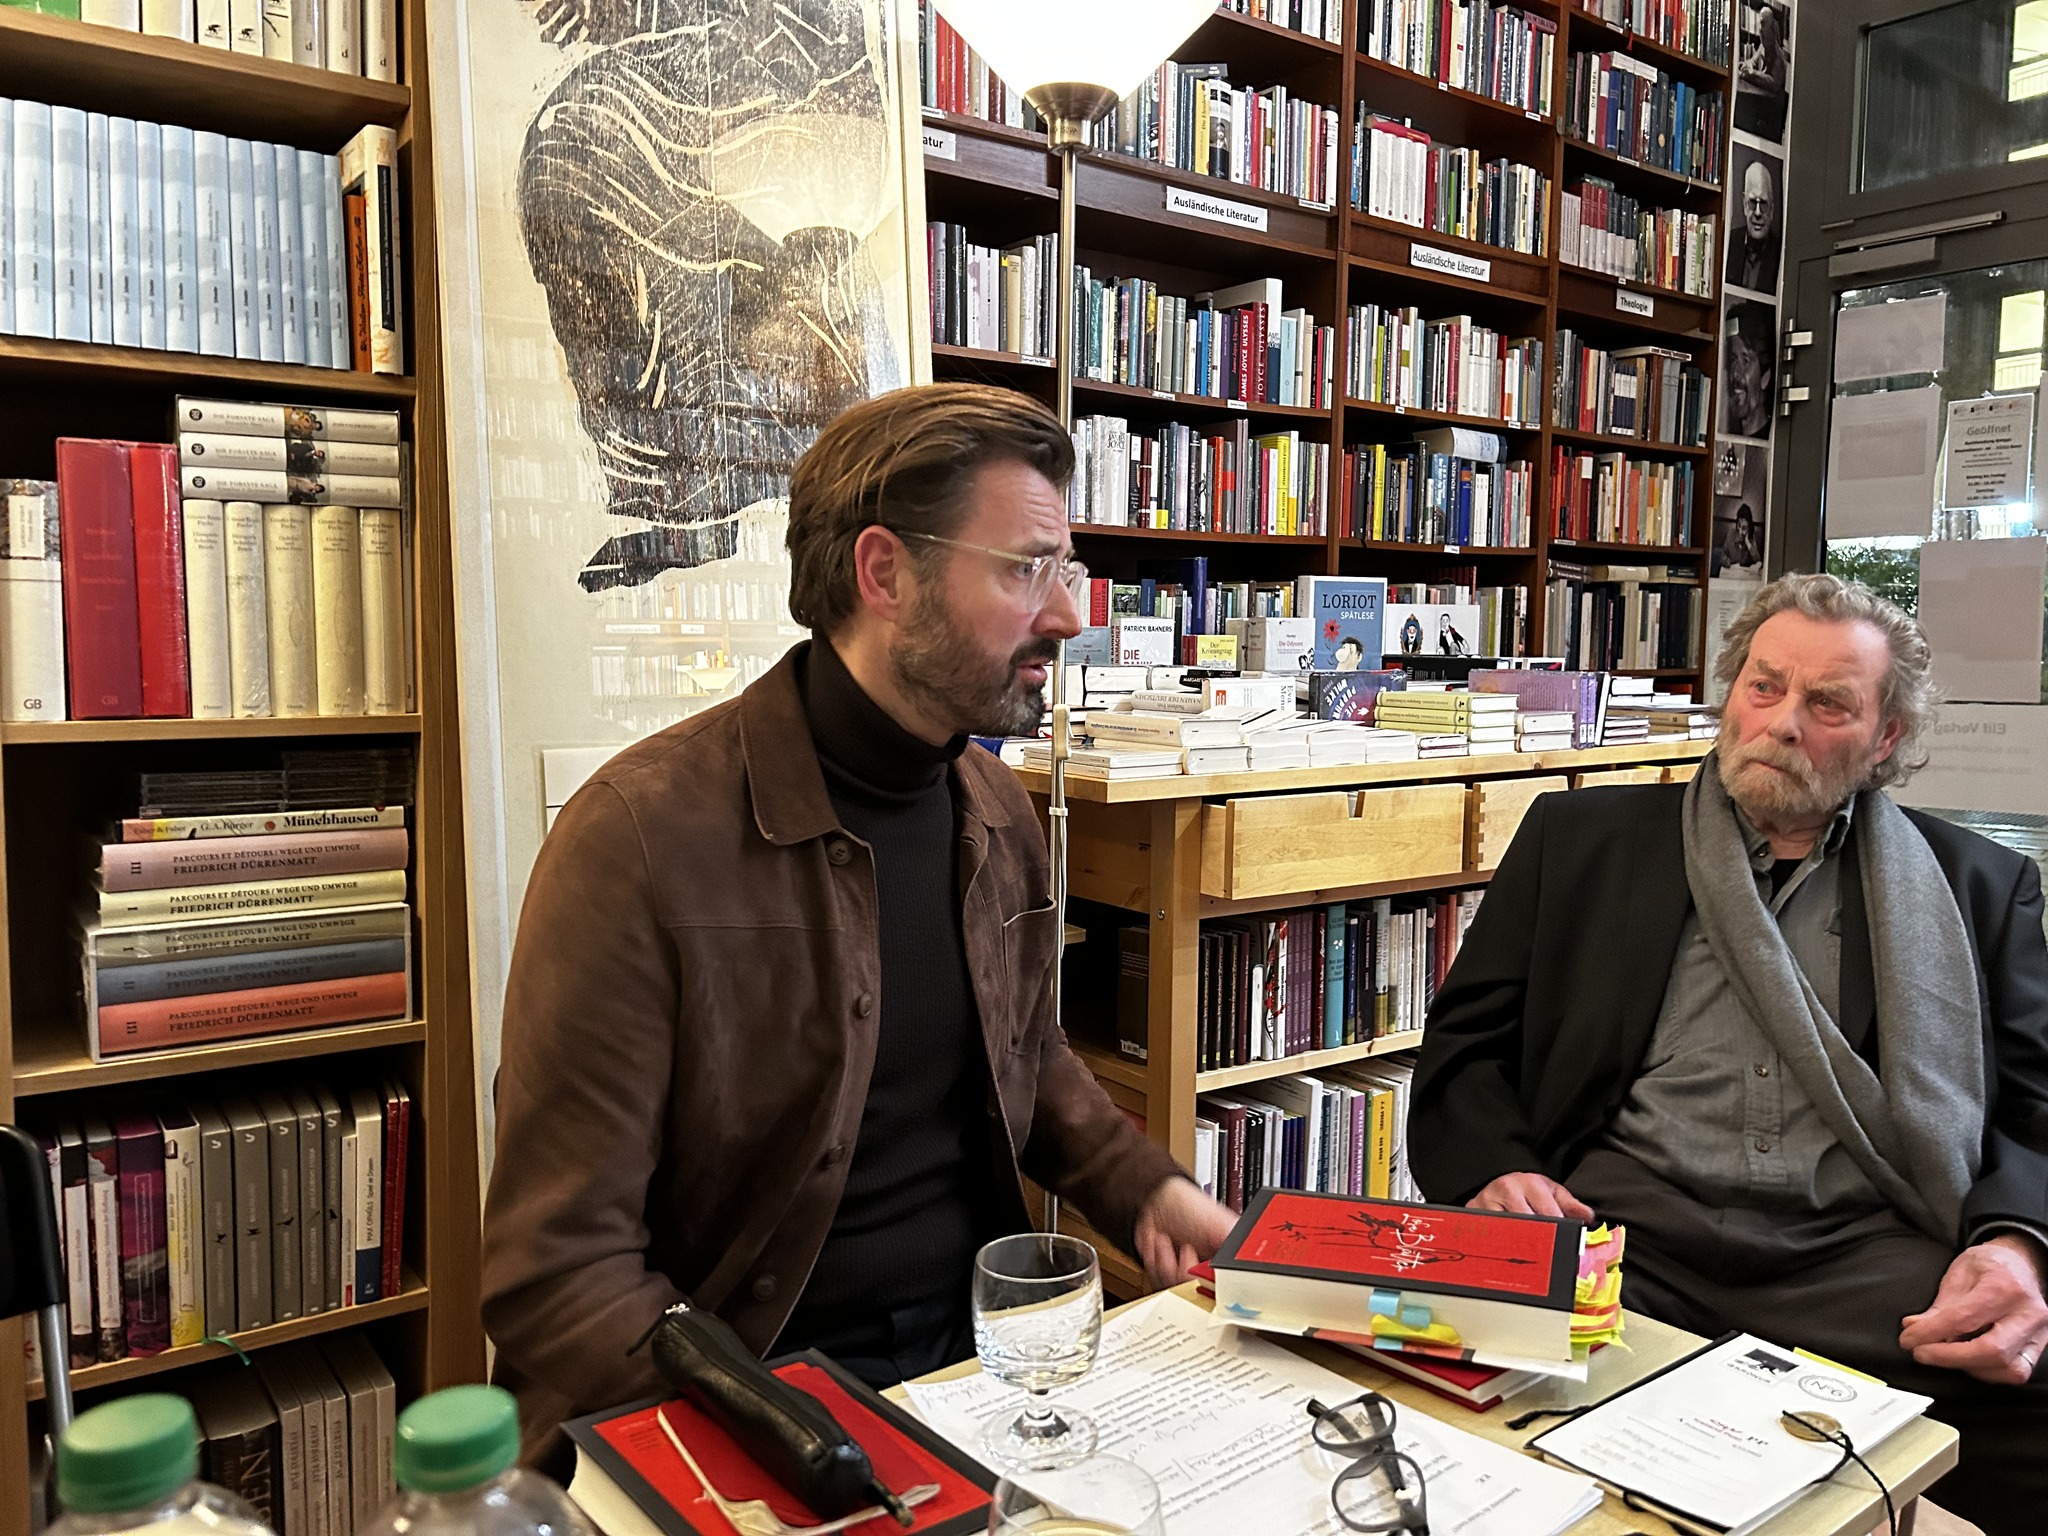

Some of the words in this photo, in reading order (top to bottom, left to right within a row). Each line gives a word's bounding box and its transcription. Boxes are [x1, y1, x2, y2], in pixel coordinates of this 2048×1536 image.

[922, 136, 944, 149] atur
[1173, 195, 1225, 217] Ausländische
[1226, 207, 1260, 224] Literatur
[1412, 250, 1456, 270] Ausländische
[1457, 260, 1486, 276] Literatur
[1620, 297, 1648, 312] Theologie
[1967, 425, 2011, 435] Geöffnet
[1107, 441, 1126, 449] JOYCE
[1322, 594, 1377, 609] LORIOT
[1340, 611, 1375, 620] SPÄTLESE
[1124, 650, 1140, 659] DIE
[1202, 647, 1232, 656] Krönungstag
[1134, 694, 1167, 702] DEUTSCHEN
[1325, 679, 1348, 706] WOLKE
[24, 699, 42, 710] GB
[1344, 701, 1357, 718] DIE
[283, 813, 379, 828] Münchhausen
[173, 852, 220, 863] PARCOURS
[234, 848, 273, 859] DÉTOURS
[279, 846, 302, 856] WEGE
[304, 845, 323, 854] UND
[324, 843, 361, 853] UMWEGE
[174, 861, 238, 875] FRIEDRICH
[241, 856, 317, 870] DÜRRENMATT
[170, 892, 216, 904] PARCOURS
[230, 888, 270, 898] DÉTOURS
[276, 886, 299, 895] WEGE
[301, 884, 320, 892] UND
[321, 882, 358, 892] UMWEGE
[170, 900, 234, 915] FRIEDRICH
[237, 895, 314, 909] DÜRRENMATT
[165, 932, 213, 943] PARCOURS
[227, 927, 267, 938] DÉTOURS
[273, 924, 296, 935] WEGE
[298, 923, 318, 931] UND
[319, 919, 356, 930] UMWEGE
[167, 940, 231, 953] FRIEDRICH
[234, 934, 312, 947] DÜRRENMATT
[167, 977, 232, 990] FRIEDRICH
[235, 967, 312, 982] DÜRRENMATT
[169, 1009, 217, 1020] PARCOURS
[230, 1003, 269, 1014] DÉTOURS
[276, 1000, 300, 1010] WEGE
[301, 998, 321, 1006] UND
[322, 992, 359, 1003] UMWEGE
[169, 1016, 233, 1031] FRIEDRICH
[237, 1006, 315, 1023] DÜRRENMATT
